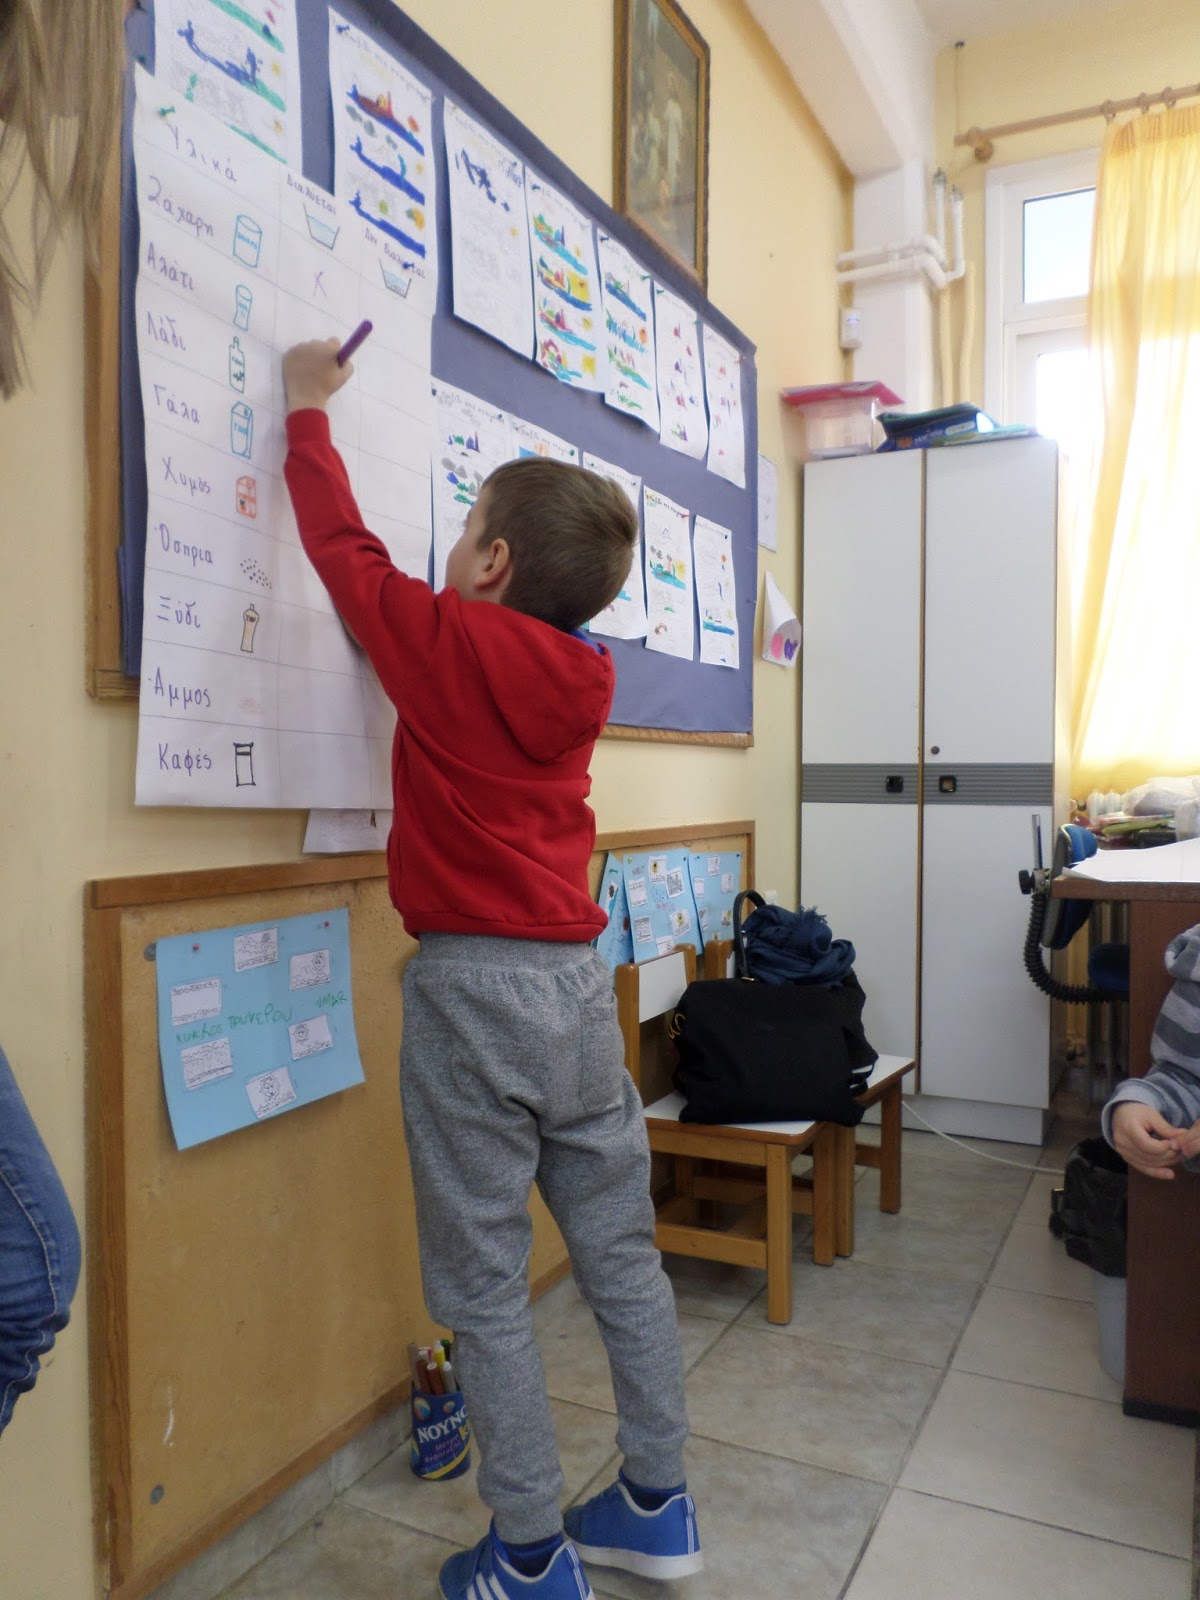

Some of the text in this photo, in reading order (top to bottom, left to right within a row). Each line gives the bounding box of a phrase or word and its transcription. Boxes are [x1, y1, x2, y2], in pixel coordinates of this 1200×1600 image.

[147, 241, 194, 291] Αλάτι
[147, 311, 186, 351] Λάδι
[153, 383, 200, 424] Γάλα
[156, 595, 201, 629] Ξύδι
[158, 743, 212, 777] Καφές
